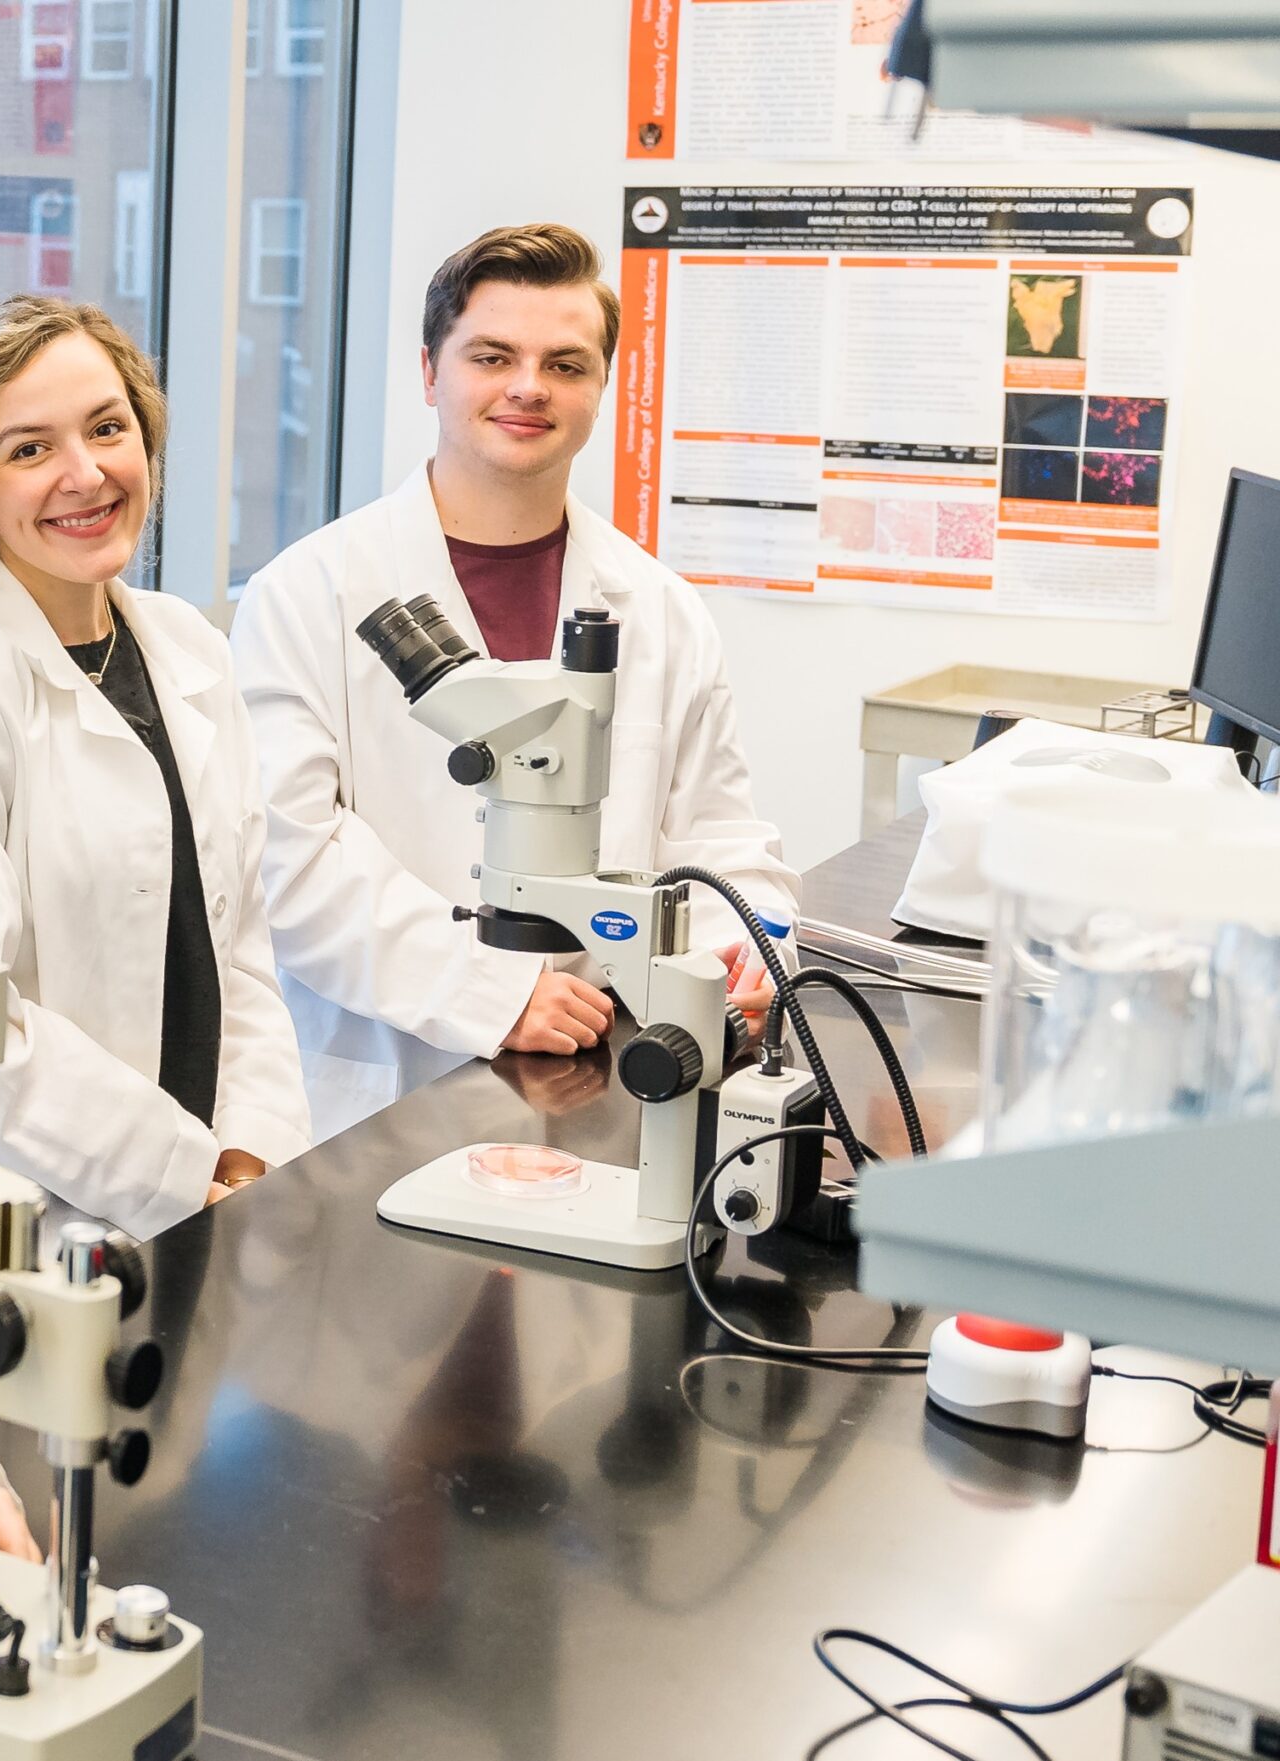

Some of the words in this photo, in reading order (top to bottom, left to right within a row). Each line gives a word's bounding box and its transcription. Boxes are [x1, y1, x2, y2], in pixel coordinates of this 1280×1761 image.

[653, 52, 670, 116] Kentucky
[713, 201, 726, 211] OF
[813, 201, 833, 211] AND
[877, 201, 890, 211] OF
[1058, 203, 1076, 213] FOR
[918, 216, 935, 226] THE
[936, 216, 955, 227] END
[956, 216, 969, 227] OF
[970, 216, 988, 227] LIFE
[643, 257, 658, 321] Medicine
[640, 325, 657, 408] Osteopathic
[640, 409, 653, 425] of
[637, 427, 655, 480] College
[636, 482, 652, 545] Kentucky
[595, 916, 634, 926] OLYMPUS
[723, 1109, 776, 1125] OLYMPUS
